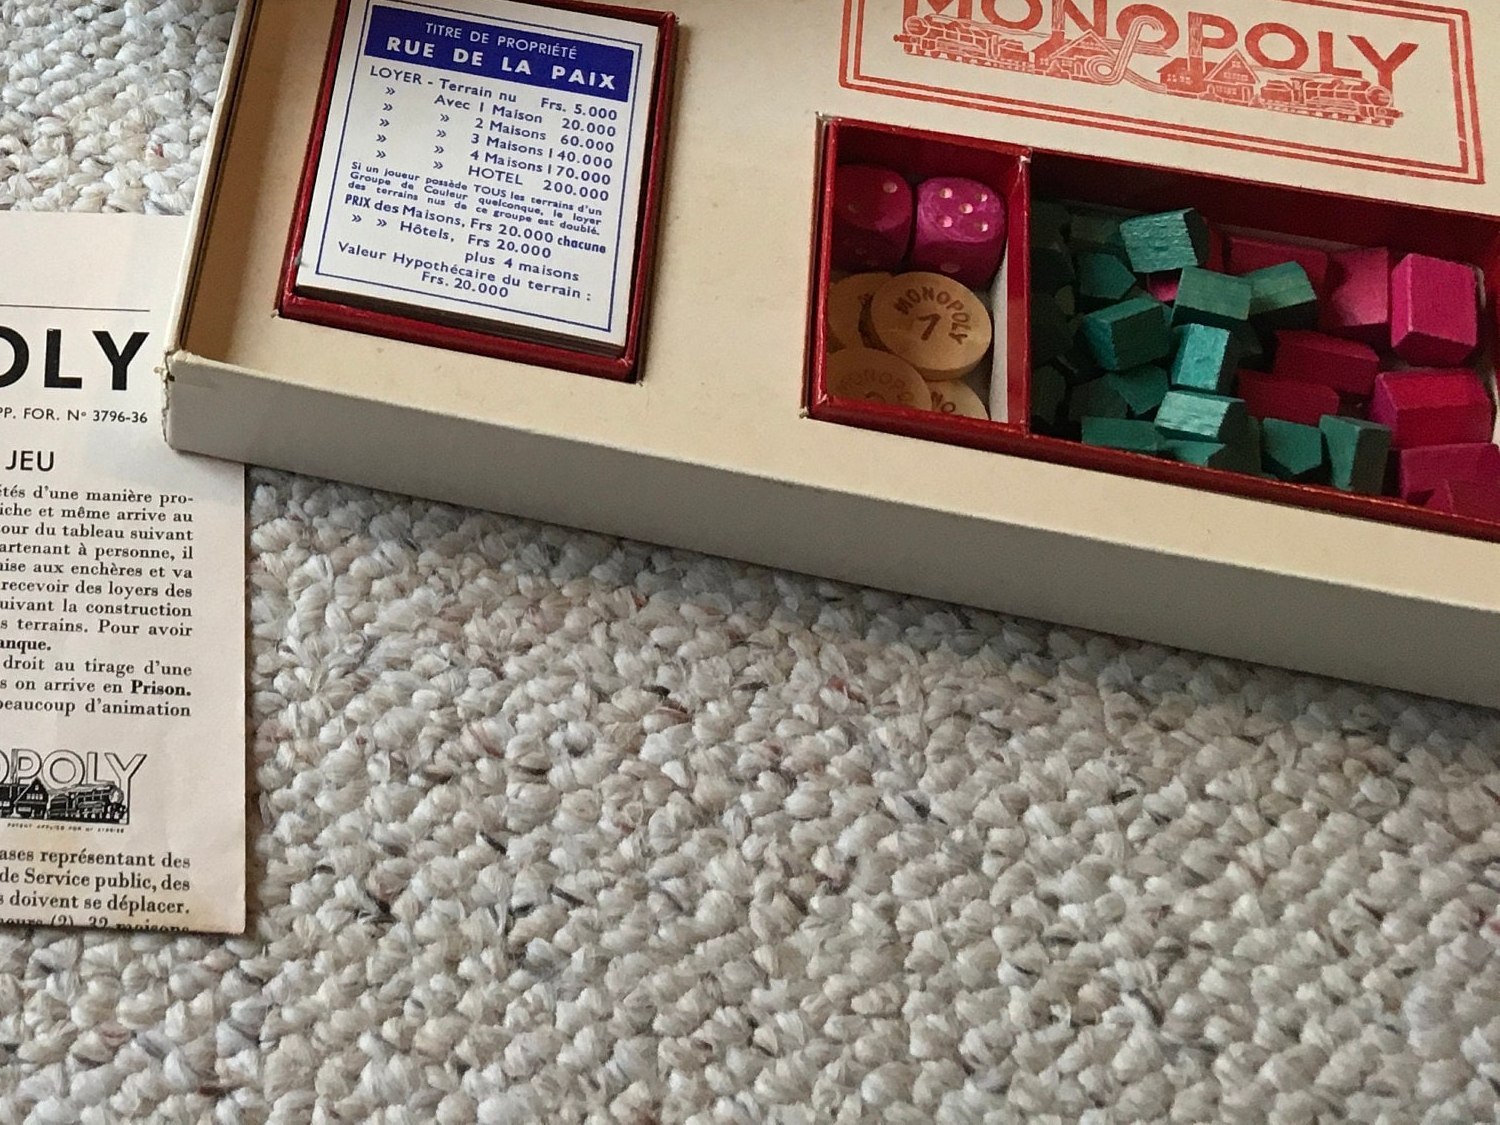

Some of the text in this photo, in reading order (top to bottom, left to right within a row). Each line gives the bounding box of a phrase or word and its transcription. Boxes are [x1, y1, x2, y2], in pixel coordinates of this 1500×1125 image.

[426, 22, 577, 60] TITRE DE PROPRIÉTÉ
[387, 36, 615, 90] RUE DE LA PAIX
[370, 65, 617, 121] LOYER Terrain nu Frs. 5.000
[433, 94, 471, 110] Avec
[492, 104, 543, 124] Maison
[561, 117, 616, 137] 20.000
[471, 133, 480, 144] 3
[486, 135, 543, 156] Maisons
[474, 117, 614, 153] 2 Maisons 60.000
[470, 149, 479, 161] 4
[484, 151, 543, 173] Maisons
[350, 171, 602, 225] Groupe de Couleur quelconque, le loyer
[351, 161, 602, 216] Si un joueur possède TOUS les terrains d'un
[468, 165, 609, 201] HOTEL 200.000
[344, 193, 606, 254] PRIX des Maisons, Frs 20.000 chacune
[348, 181, 366, 191] des
[376, 187, 418, 201] terrains
[427, 197, 445, 206] nus
[454, 201, 467, 210] de
[492, 210, 532, 223] groupe
[537, 219, 555, 227] est
[559, 221, 600, 236] doublé.
[400, 220, 551, 259] Hôtels, Frs 20.000
[338, 241, 581, 299] Valeur Hypothécaire du terrain
[421, 271, 508, 298] Frs. 20.000
[464, 251, 579, 281] plus 4 maisons
[893, 286, 972, 345] MONOPOLY
[23, 407, 60, 421] FOR.
[67, 409, 87, 421] N°
[92, 409, 148, 424] 3796-36
[5, 450, 54, 472] JEU
[33, 485, 79, 500] d'une
[85, 488, 152, 503] manière
[159, 494, 194, 508] pro-
[40, 847, 156, 869] représentant
[161, 851, 191, 869] des
